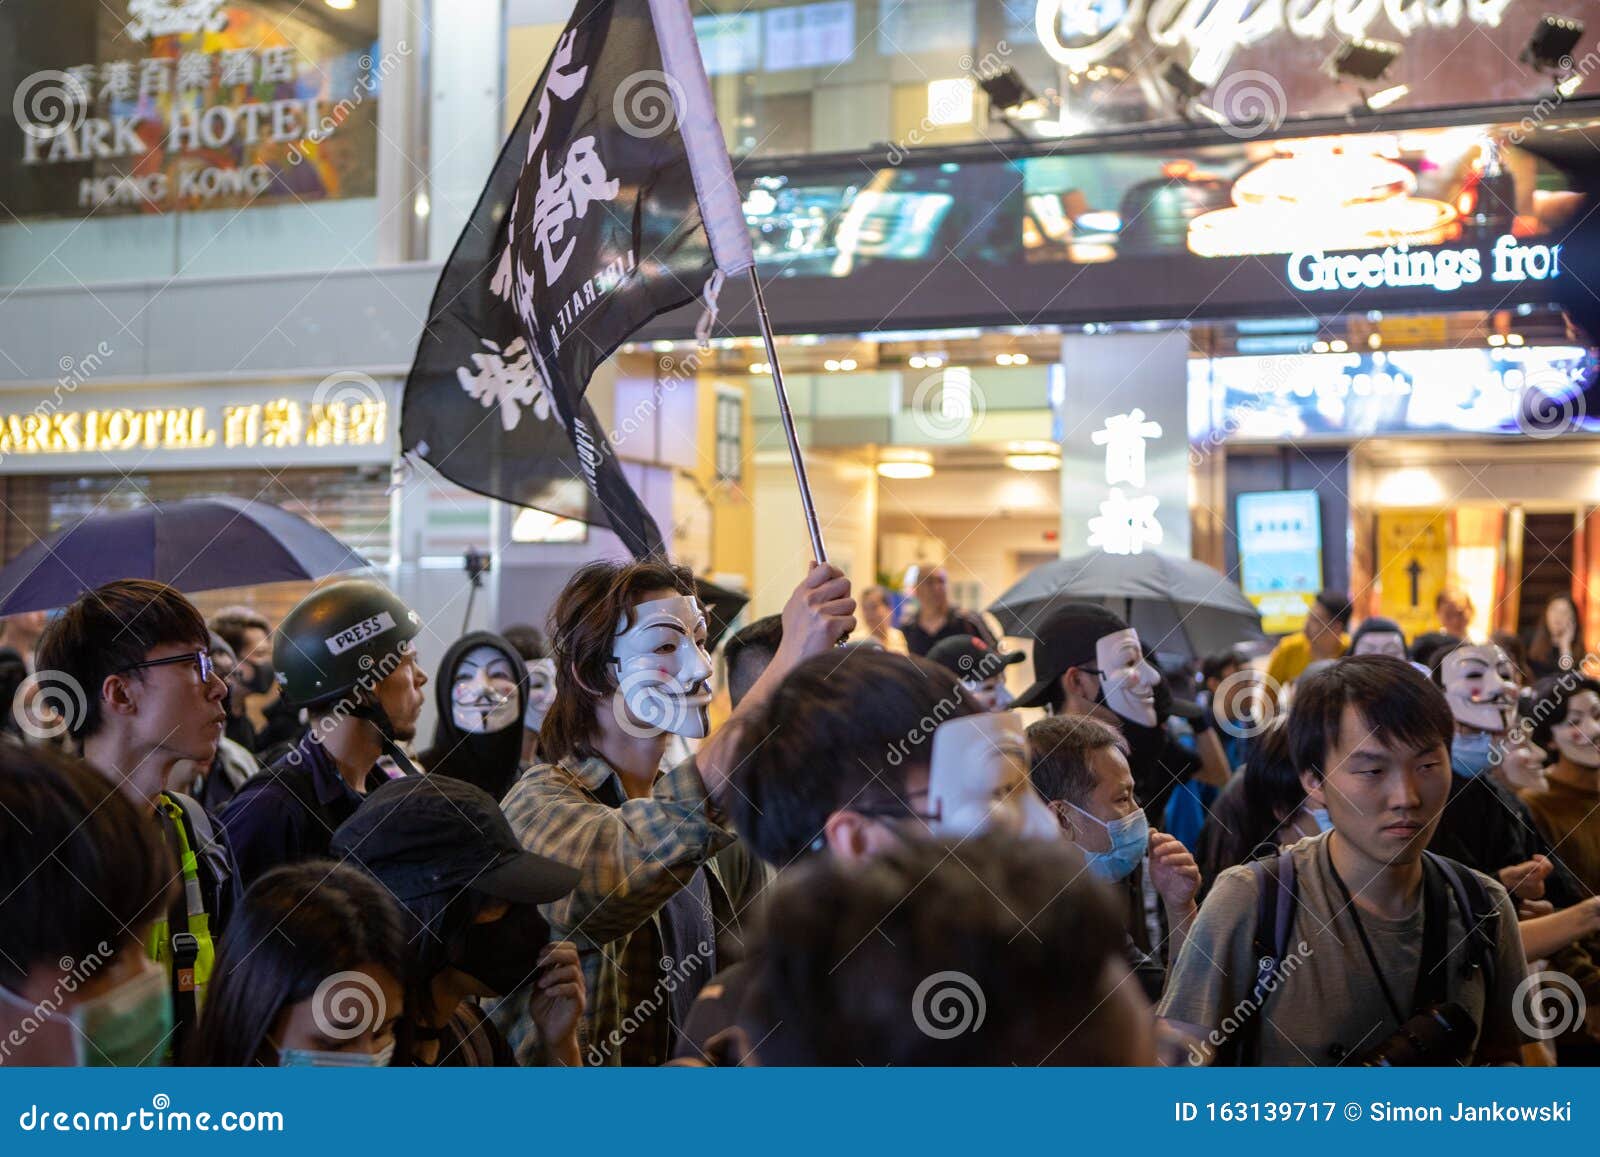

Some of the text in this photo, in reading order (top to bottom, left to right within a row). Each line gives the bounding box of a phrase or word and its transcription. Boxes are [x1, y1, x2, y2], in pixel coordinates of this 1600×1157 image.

[21, 99, 334, 165] PARK HOTEL
[79, 164, 272, 207] HONG KONG
[1287, 241, 1482, 291] Greetings
[0, 411, 82, 454] ARK
[335, 617, 381, 648] PRESS
